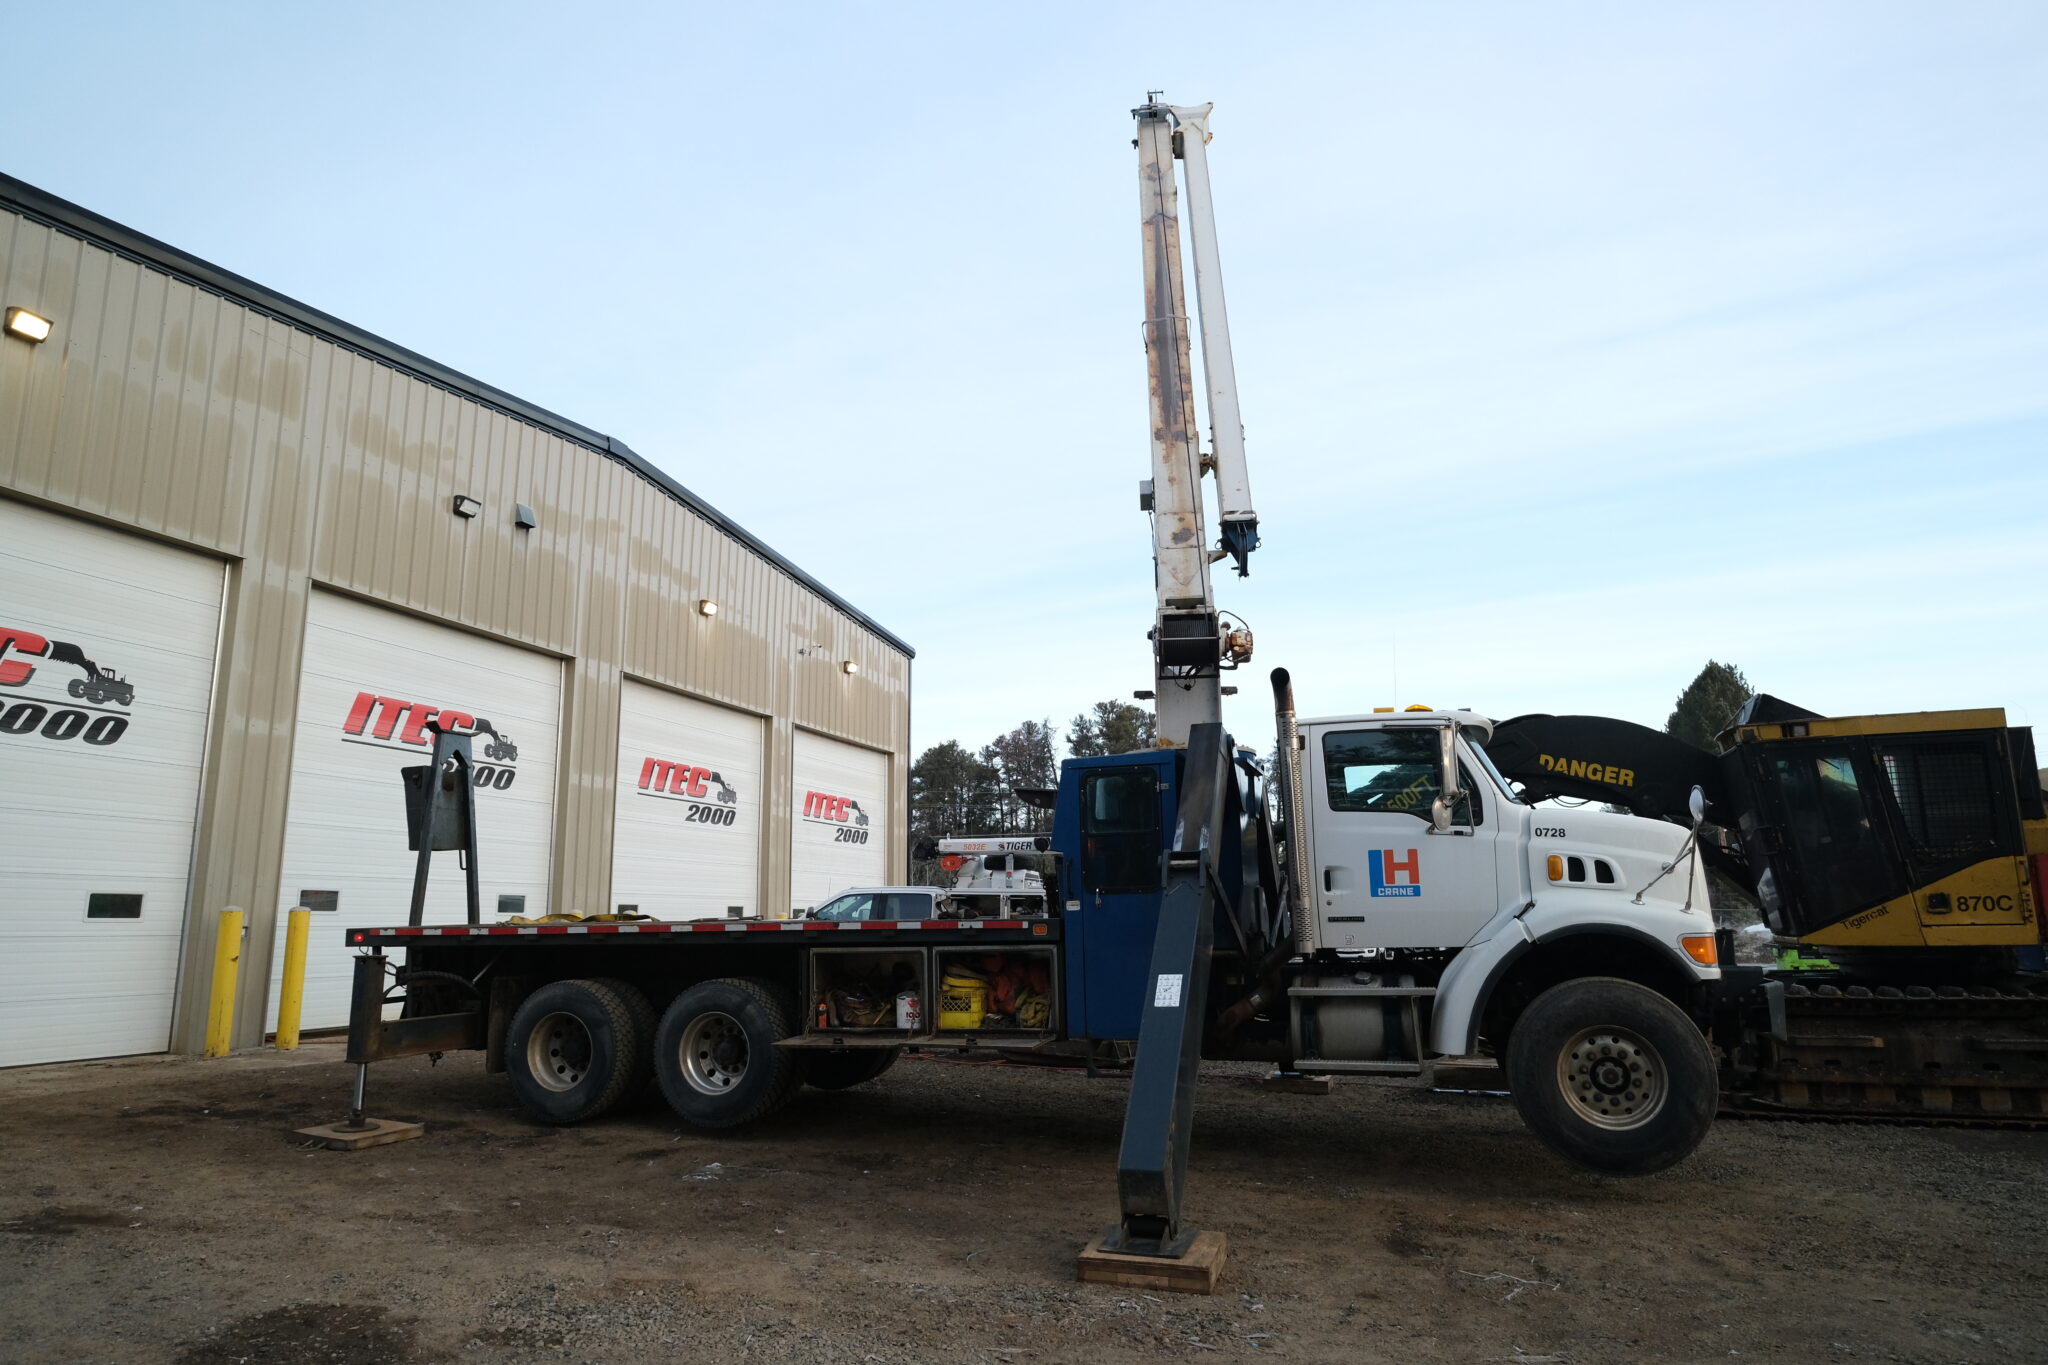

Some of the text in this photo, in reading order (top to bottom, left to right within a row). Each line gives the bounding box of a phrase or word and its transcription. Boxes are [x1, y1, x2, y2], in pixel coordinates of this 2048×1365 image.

[0, 701, 129, 745] 000
[637, 757, 711, 798] ITEC
[1538, 753, 1636, 787] DANGER
[685, 804, 736, 826] 2000
[803, 790, 851, 822] ITEC
[834, 828, 869, 845] 2000
[1535, 828, 1566, 838] 0728
[1006, 841, 1032, 850] TIGER
[1377, 887, 1414, 896] CRANE
[1957, 895, 2013, 912] 870C
[1840, 905, 1890, 931] Tigercat
